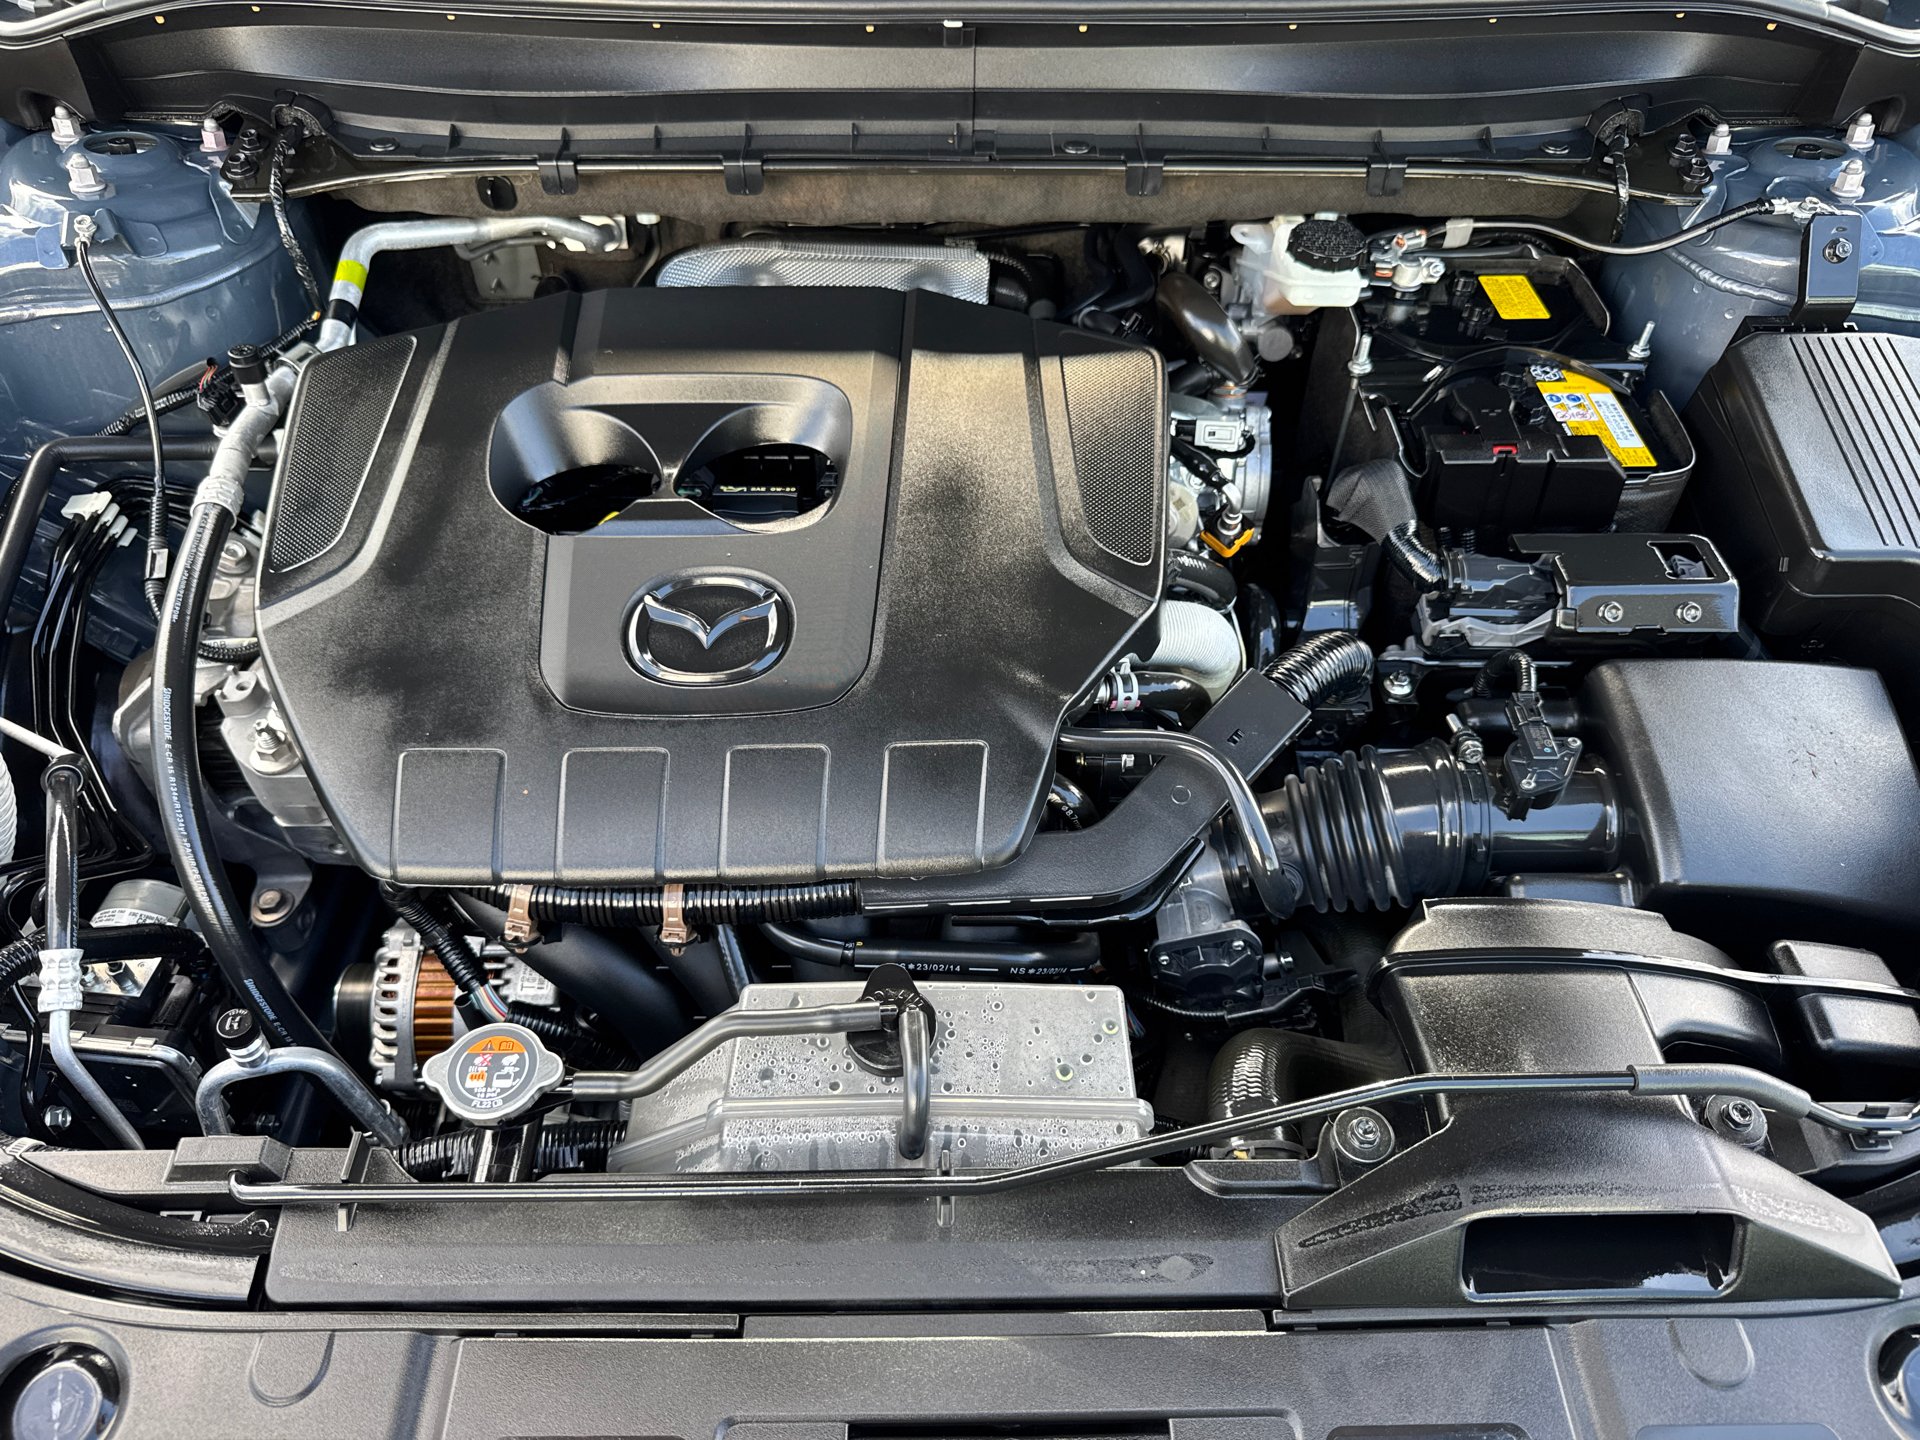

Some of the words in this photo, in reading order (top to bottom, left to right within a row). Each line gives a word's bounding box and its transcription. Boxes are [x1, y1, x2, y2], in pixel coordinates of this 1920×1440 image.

[163, 687, 173, 741] BRIDGESTONE
[165, 743, 174, 763] E-CR
[167, 765, 175, 774] 15
[916, 963, 961, 972] 23/02/14
[243, 978, 278, 1021] BRIDGESTONE
[471, 1099, 492, 1108] FL22
